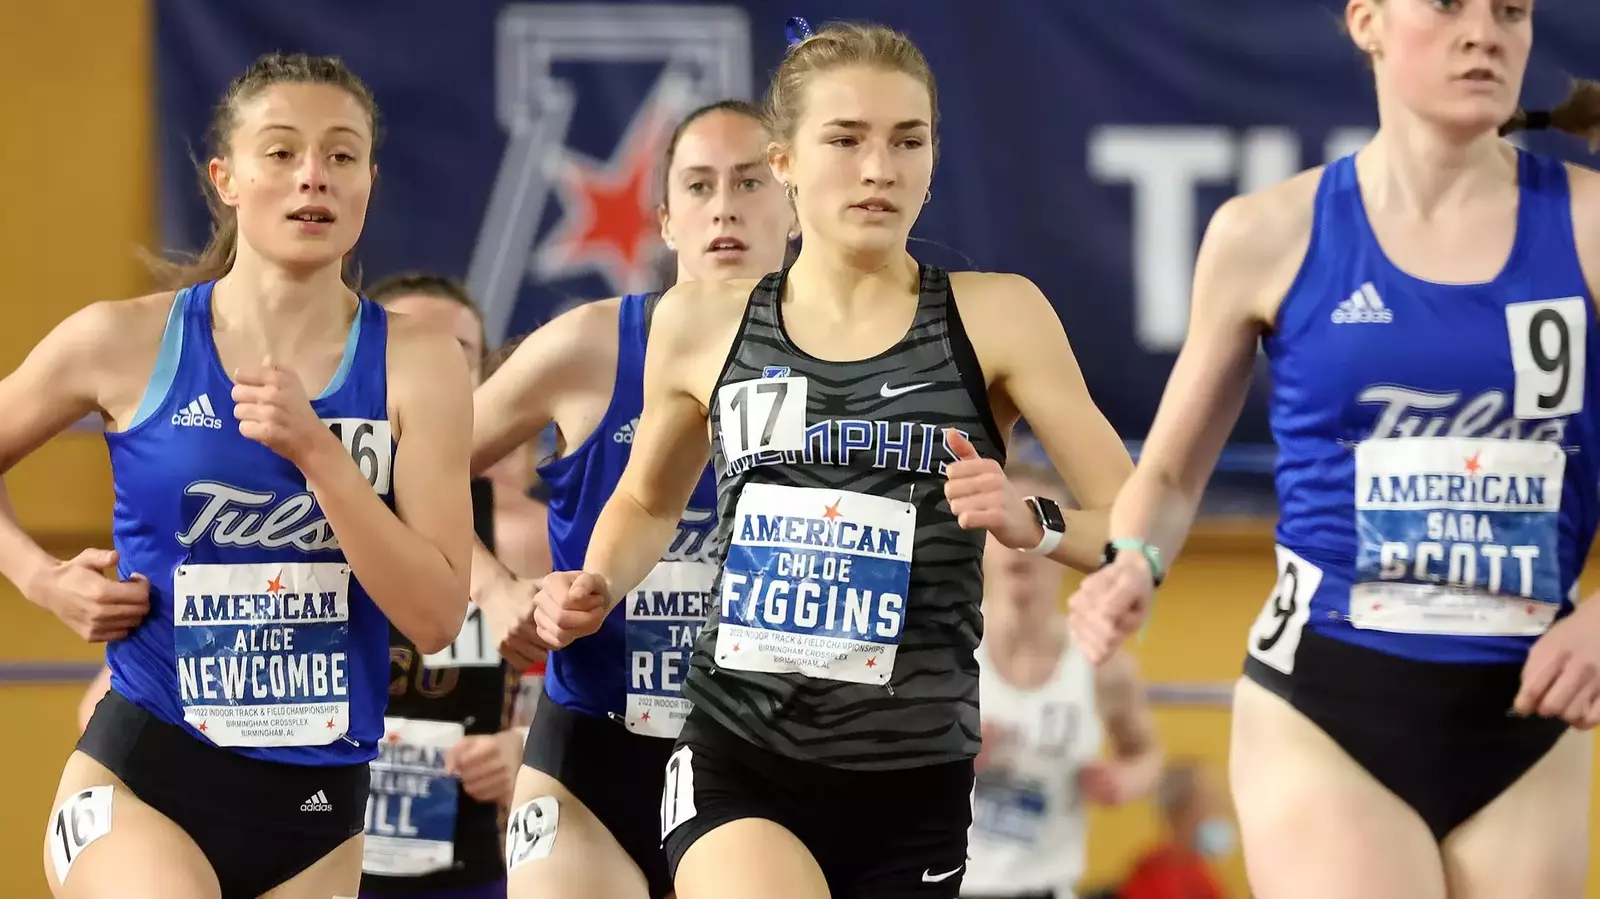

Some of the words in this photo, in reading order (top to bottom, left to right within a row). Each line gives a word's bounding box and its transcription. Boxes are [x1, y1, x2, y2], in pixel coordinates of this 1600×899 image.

[1331, 308, 1393, 324] adidas
[1528, 308, 1571, 410] 9
[171, 413, 222, 430] adidas
[730, 382, 788, 452] 17
[1366, 474, 1547, 505] AMERICAN
[175, 480, 343, 553] Tuls
[1426, 511, 1494, 543] SARA
[739, 514, 900, 556] AMERICAN
[777, 552, 852, 583] CHLOE
[1379, 541, 1541, 598] SCOTT
[181, 591, 337, 622] AMERICAN
[720, 572, 904, 639] FIGGINS
[233, 627, 294, 653] ALICE
[758, 644, 804, 656] BIRMINGHAM
[805, 650, 849, 662] CROSSPLEX
[771, 633, 795, 646] TRACK
[804, 638, 825, 649] FIELD
[826, 641, 885, 654] CHAMPIONSHIPS
[178, 652, 348, 701] NEWCOMBE
[209, 708, 234, 718] INDOOR
[235, 707, 259, 717] TRACK
[267, 706, 286, 717] FIELD
[286, 705, 339, 716] CHAMPIONSHIPS
[653, 699, 679, 710] INDOOR
[225, 719, 268, 728] BIRMINGHAM
[270, 718, 309, 727] CROSSPLEX
[300, 803, 333, 812] adidas
[55, 791, 95, 864] 16
